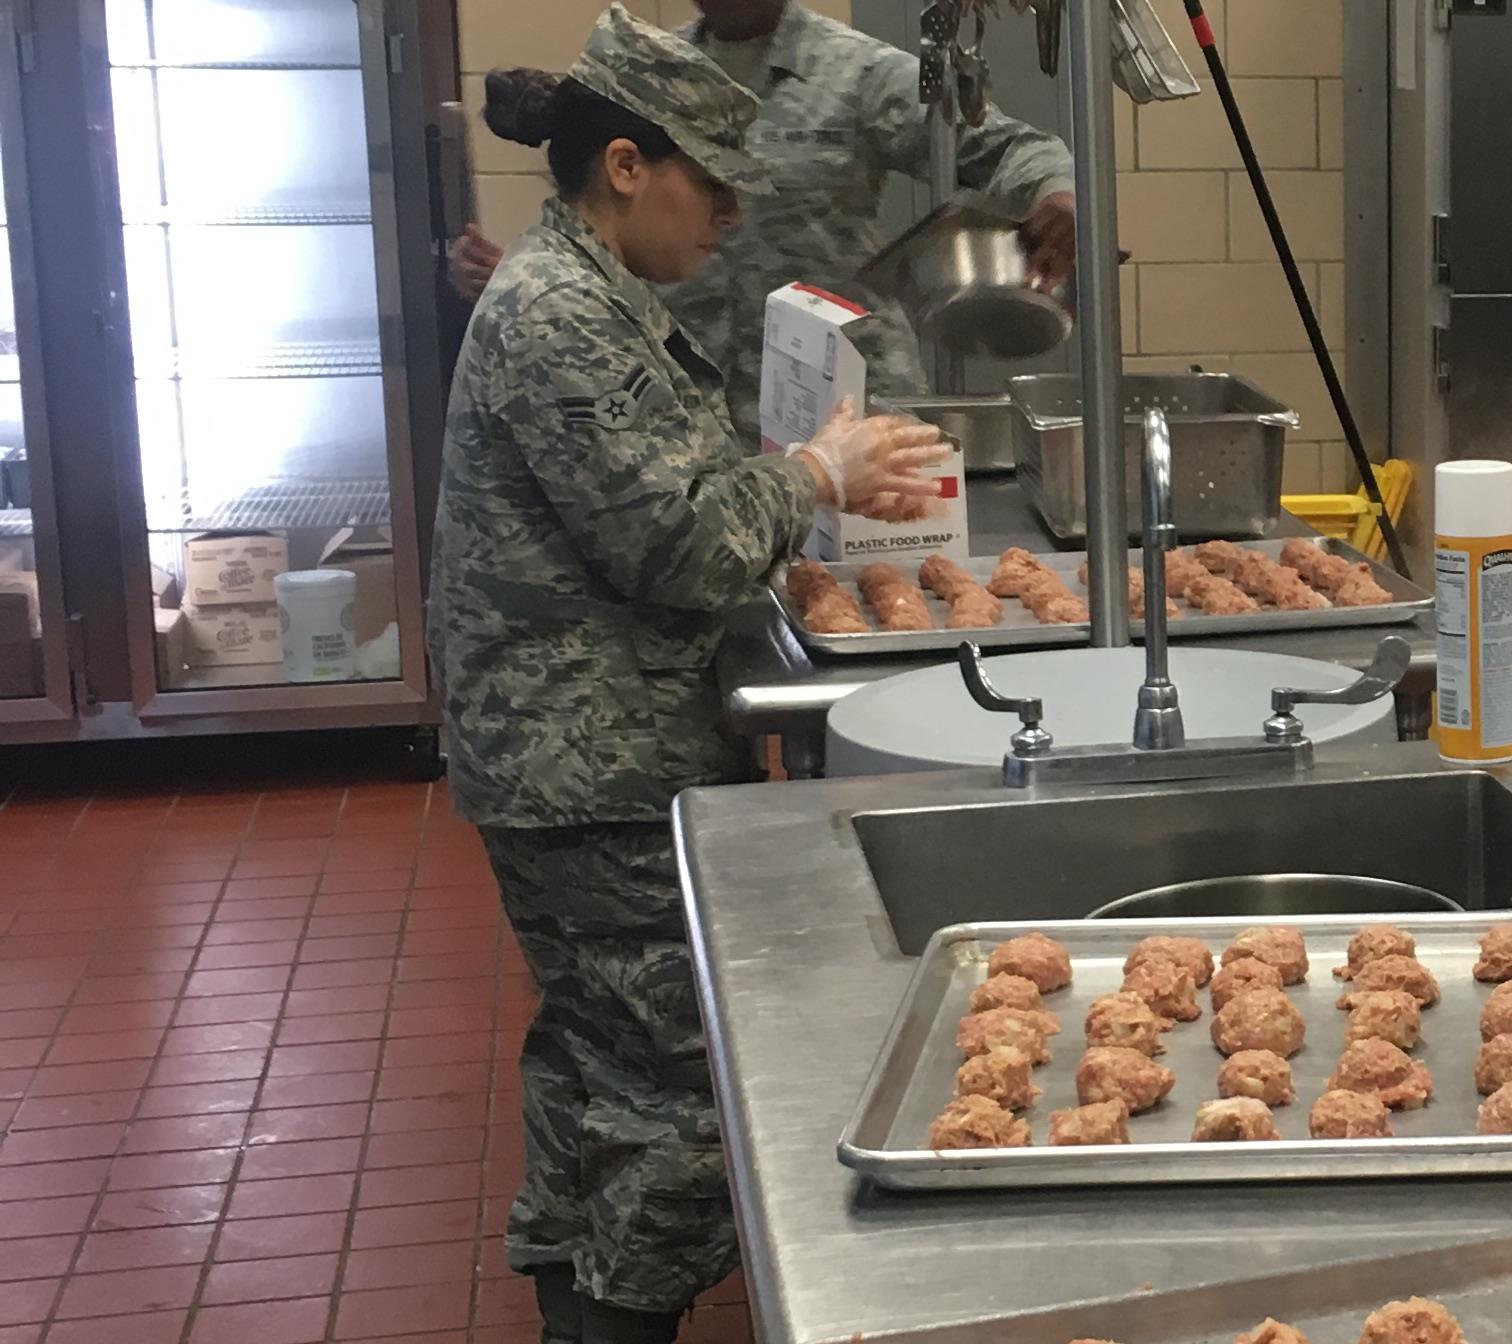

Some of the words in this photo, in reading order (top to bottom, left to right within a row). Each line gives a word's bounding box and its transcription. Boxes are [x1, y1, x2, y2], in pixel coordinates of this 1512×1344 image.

[845, 539, 888, 550] PLASTIC
[890, 536, 921, 546] FOOD
[922, 533, 953, 544] WRAP
